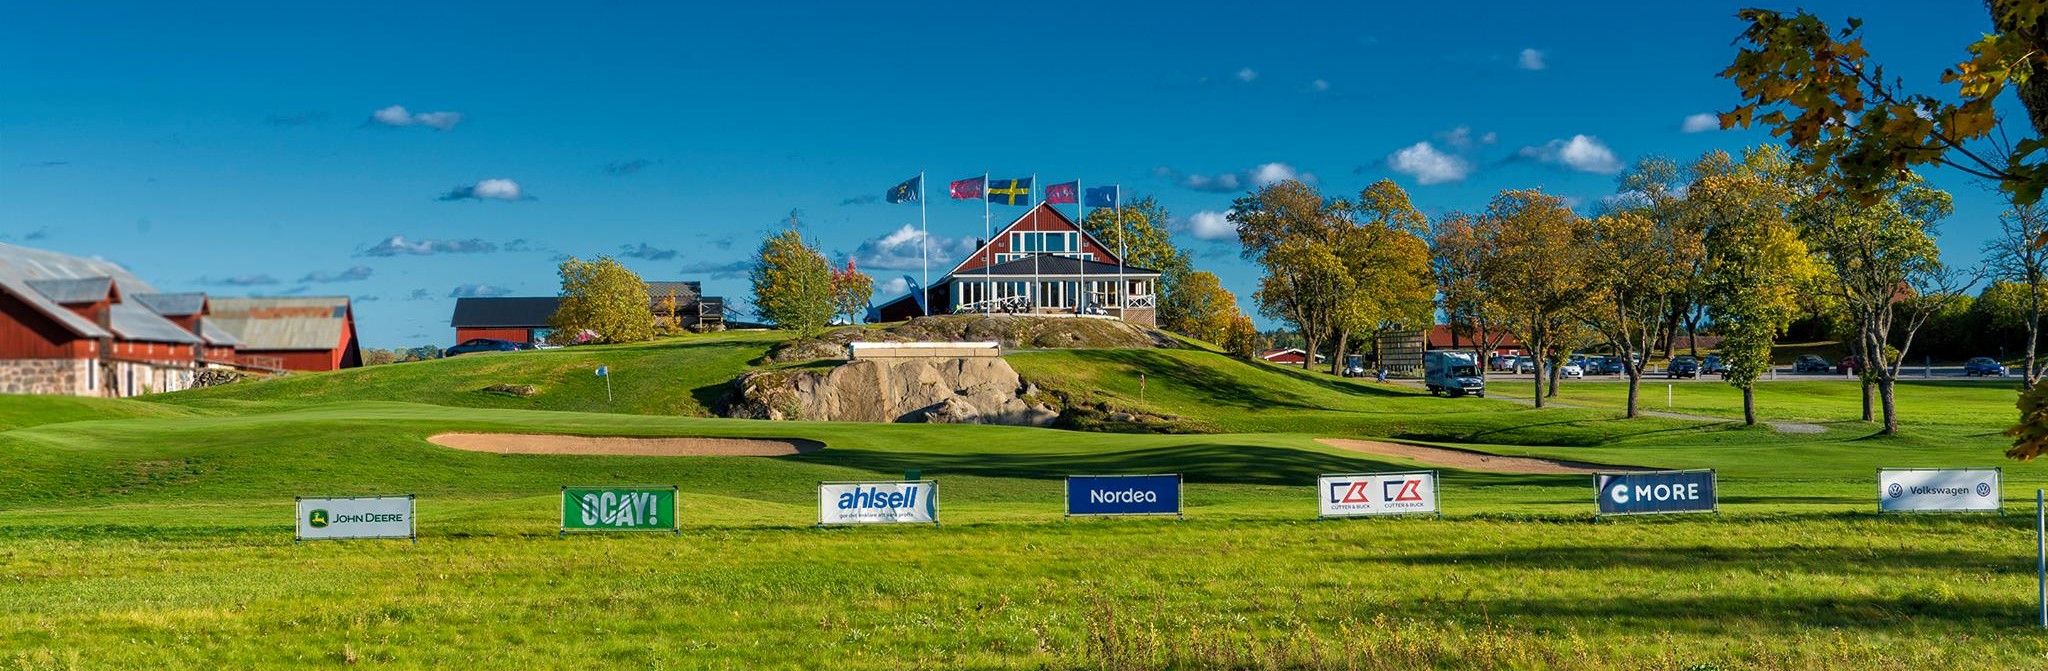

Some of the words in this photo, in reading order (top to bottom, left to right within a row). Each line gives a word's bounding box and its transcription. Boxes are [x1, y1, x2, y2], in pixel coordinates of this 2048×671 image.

[838, 486, 918, 510] ahlsell
[1090, 488, 1157, 503] Nordea
[1611, 484, 1629, 504] C
[1635, 483, 1699, 502] MORE
[1910, 486, 1969, 497] Volkswagen
[333, 513, 364, 524] JOHN
[365, 512, 403, 523] DEERE
[581, 491, 658, 527] OCAY!
